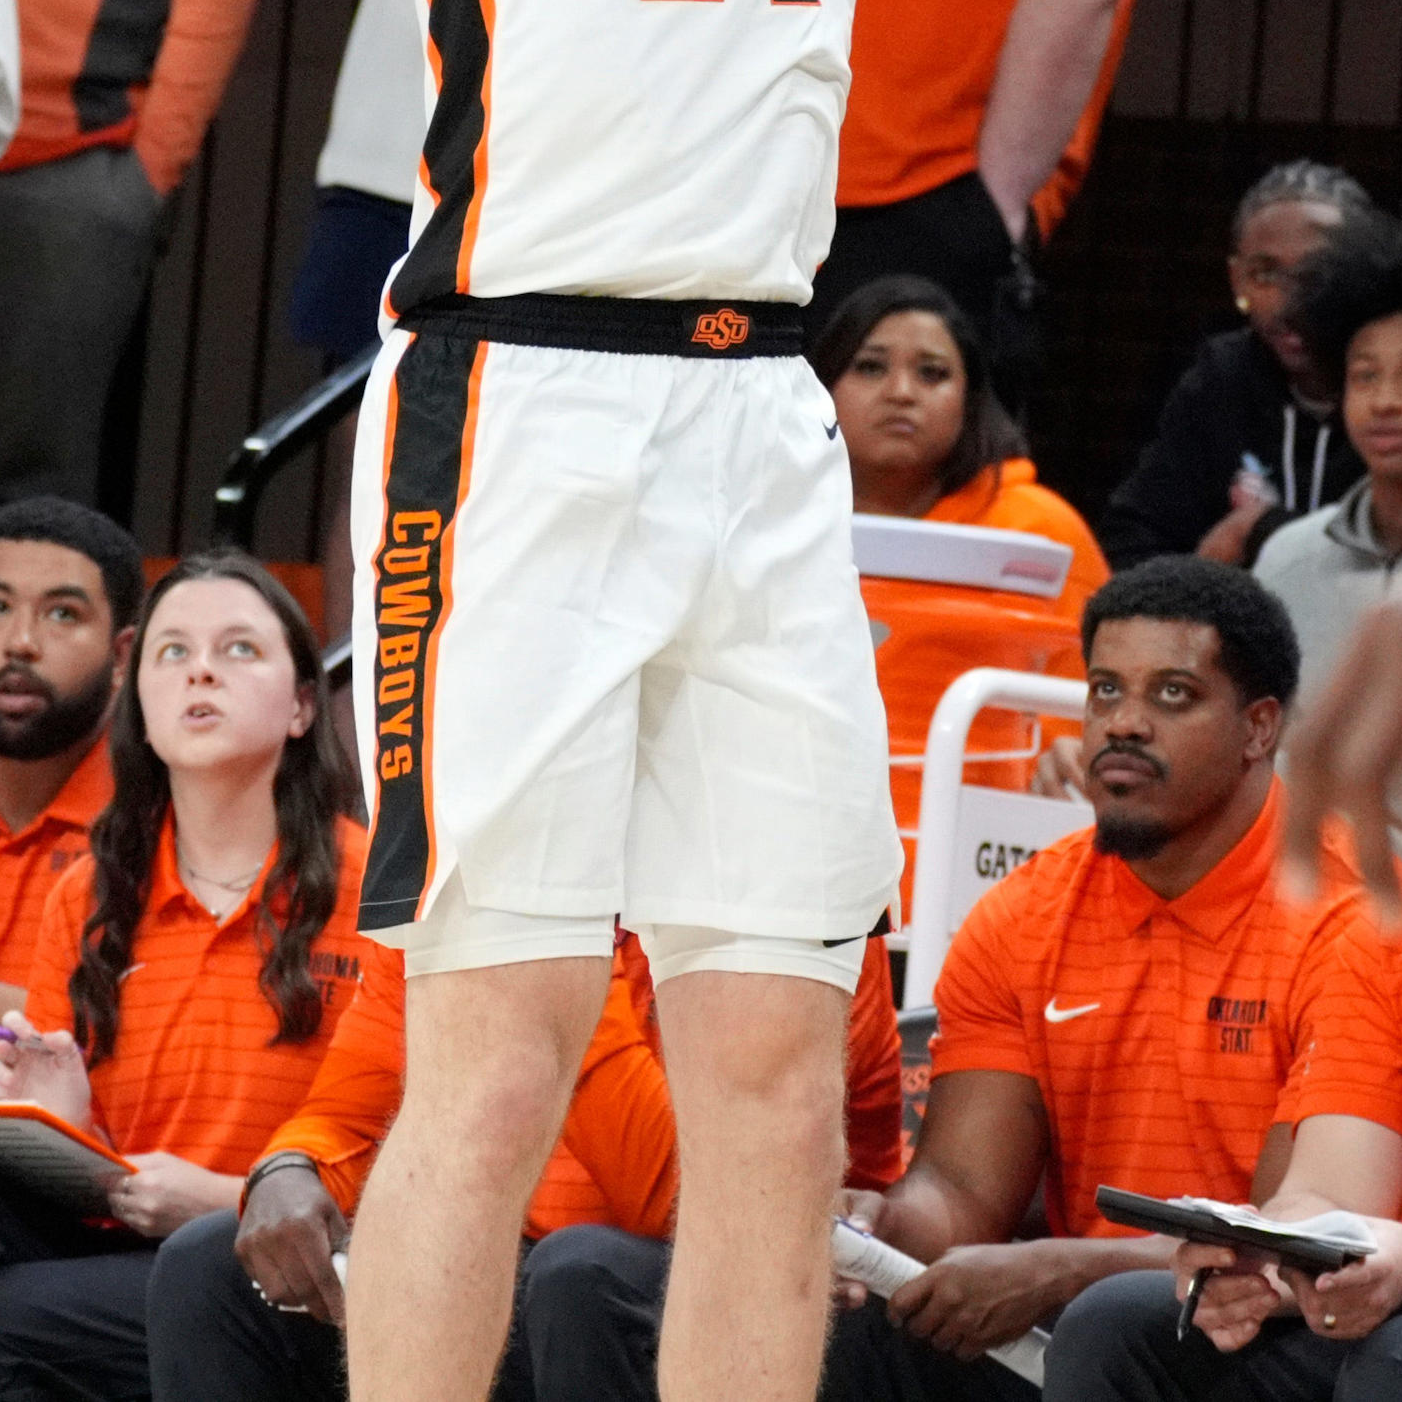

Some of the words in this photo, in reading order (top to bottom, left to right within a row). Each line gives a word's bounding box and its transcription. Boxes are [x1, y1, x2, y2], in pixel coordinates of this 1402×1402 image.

[691, 308, 749, 350] OSU
[377, 509, 442, 781] COWBOYS
[975, 841, 1038, 879] GAT
[1220, 1027, 1253, 1053] STAT
